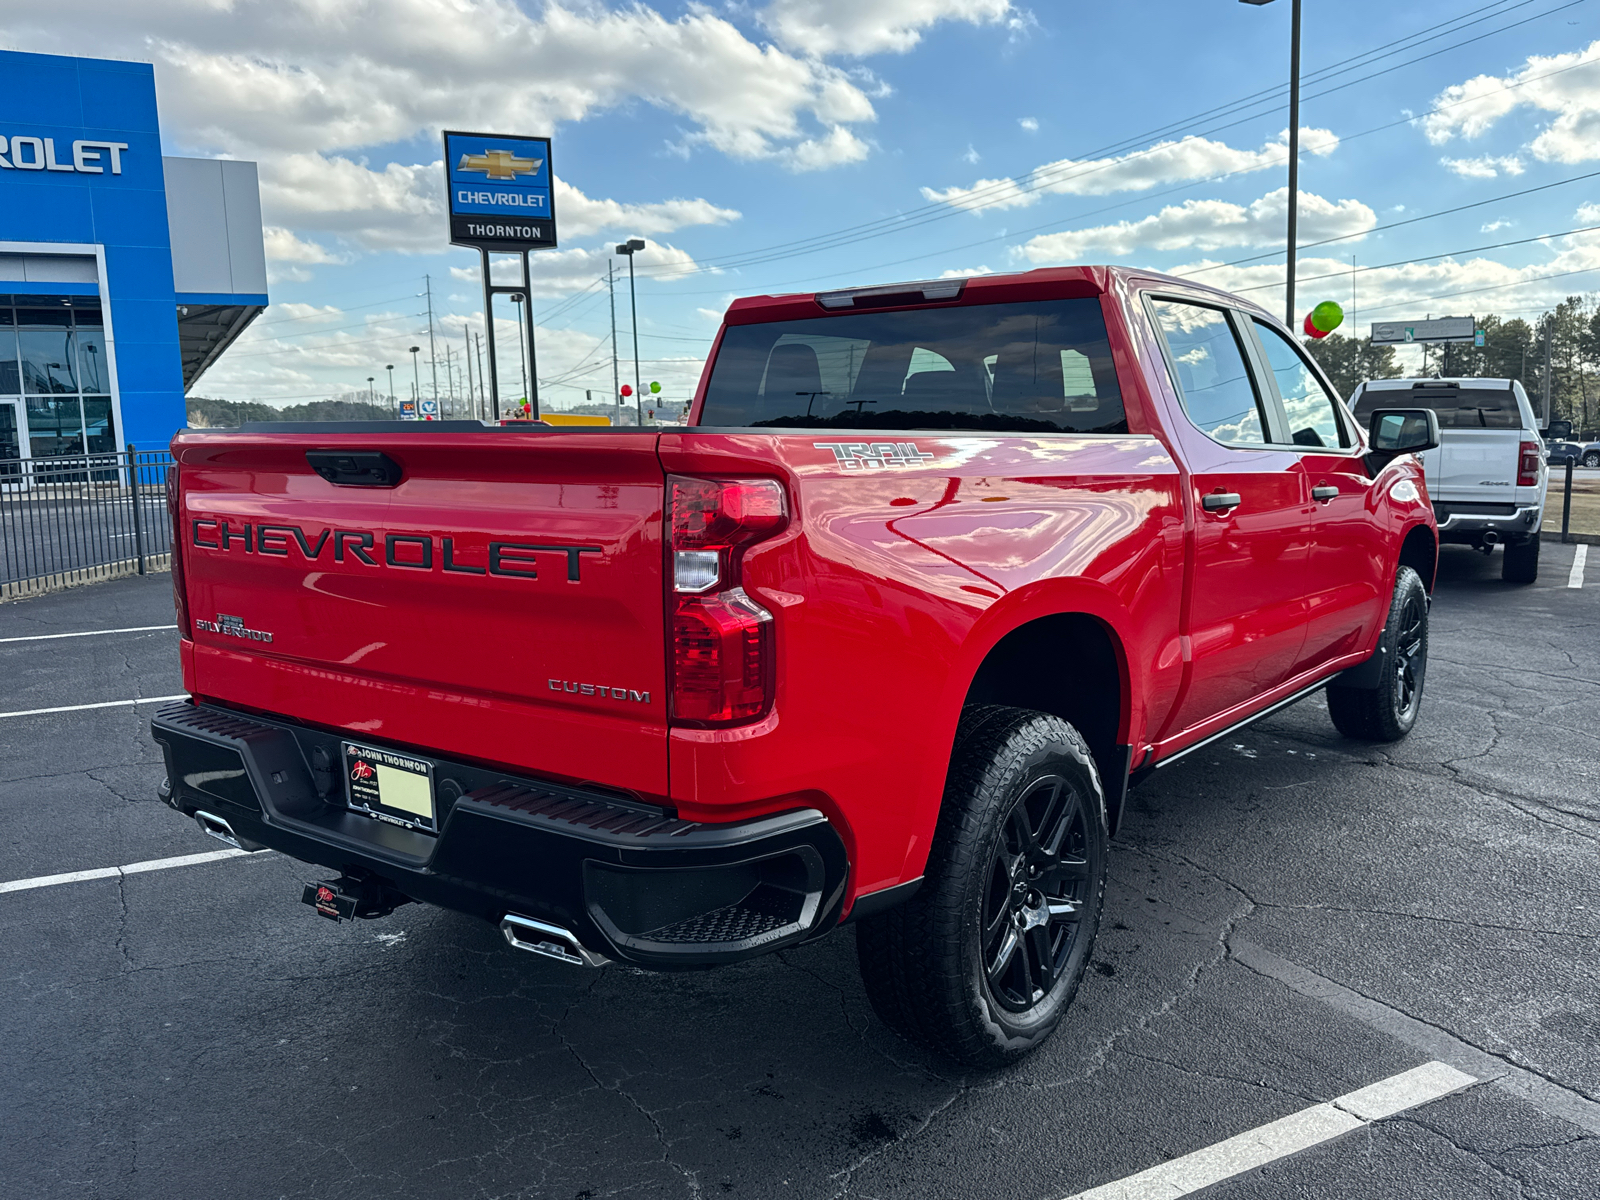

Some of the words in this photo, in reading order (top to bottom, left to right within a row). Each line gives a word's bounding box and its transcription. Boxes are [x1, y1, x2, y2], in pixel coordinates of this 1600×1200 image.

[458, 191, 545, 207] CHEVROLET
[467, 224, 541, 238] THORNTON
[812, 442, 934, 459] TRAIL
[838, 458, 926, 472] BOSS
[192, 519, 602, 582] CHEVROLET
[196, 619, 273, 643] SILVERADO
[548, 678, 651, 703] CUSTOM
[361, 749, 383, 761] JOHN
[383, 755, 427, 773] THORNTON
[378, 815, 404, 826] CHEVROLET
